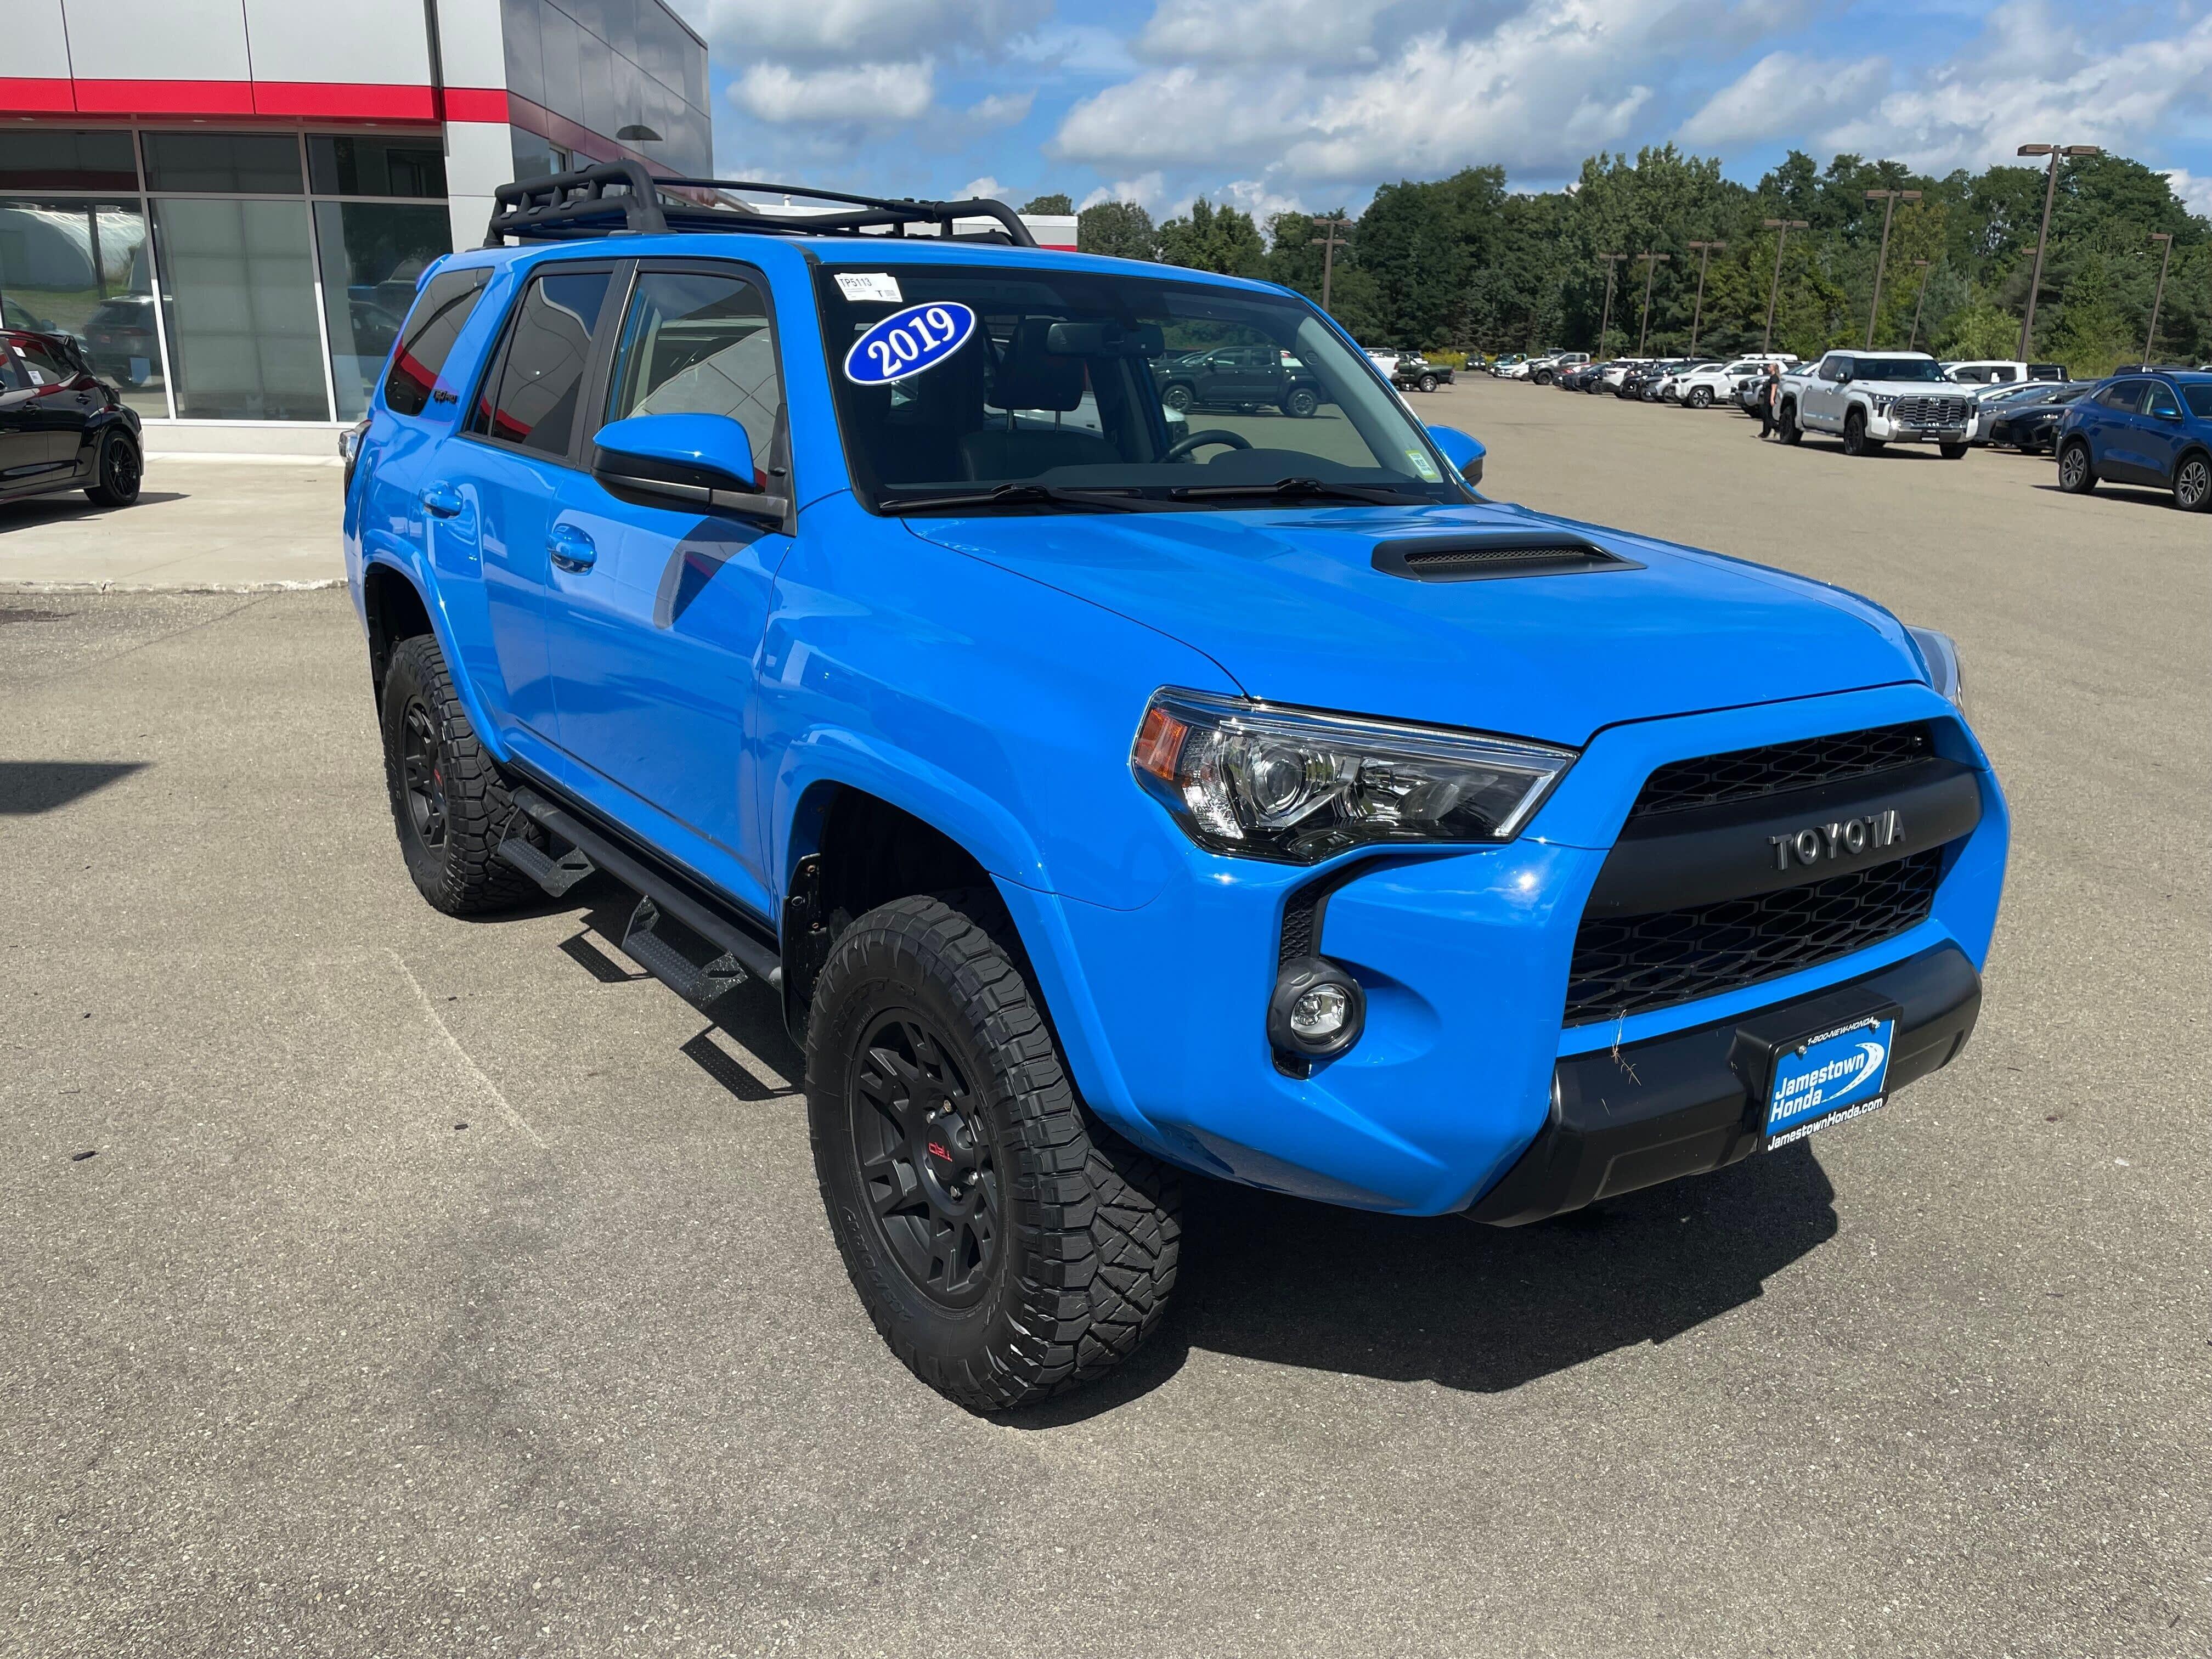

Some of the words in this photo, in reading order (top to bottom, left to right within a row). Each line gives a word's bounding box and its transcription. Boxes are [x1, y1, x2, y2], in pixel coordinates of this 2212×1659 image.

[839, 278, 872, 287] TP5113
[867, 307, 955, 377] 2019
[1768, 809, 1907, 871] TOYOTA
[1807, 1016, 1875, 1046] 1-800-NEW-HONDA
[1775, 1052, 1865, 1101] Jamestown
[1768, 1097, 1883, 1151] JamestownHonda.com
[1770, 1087, 1822, 1122] Honda
